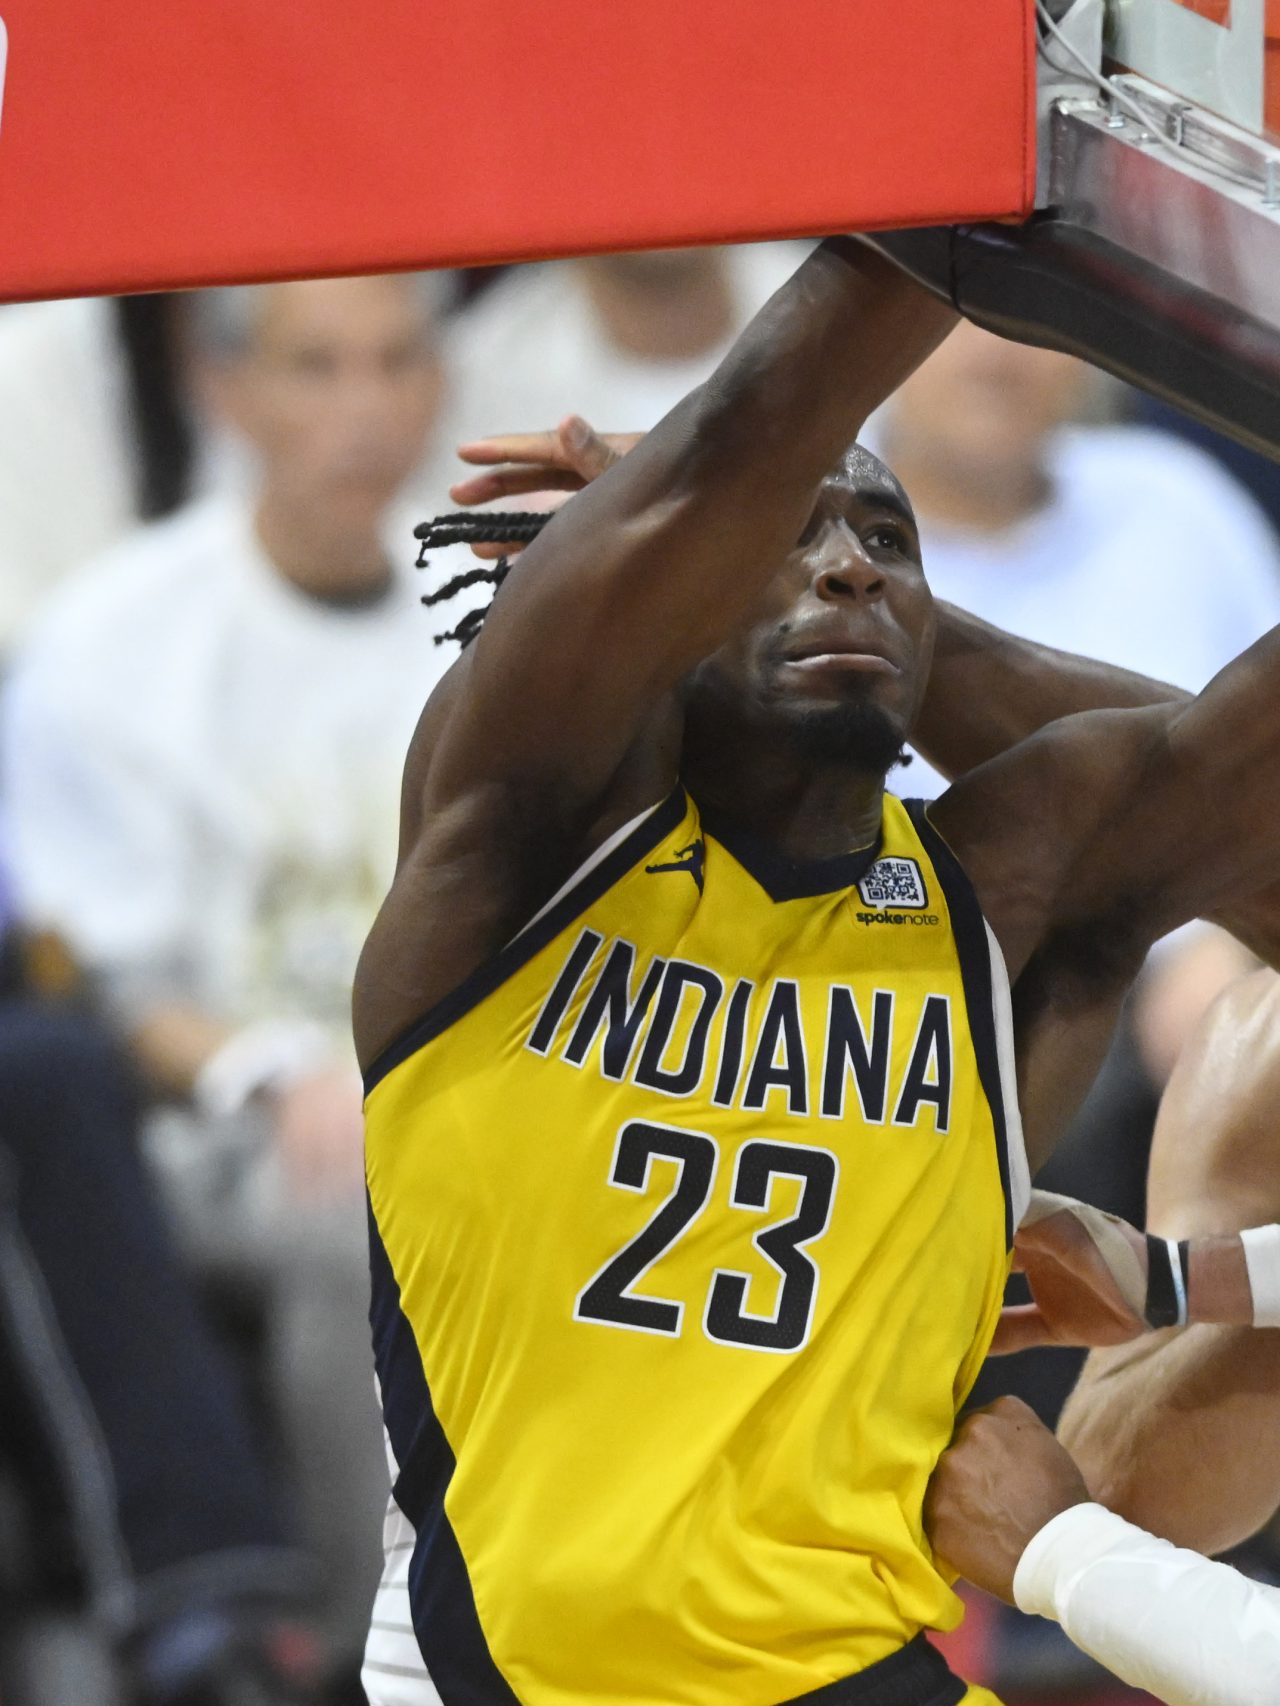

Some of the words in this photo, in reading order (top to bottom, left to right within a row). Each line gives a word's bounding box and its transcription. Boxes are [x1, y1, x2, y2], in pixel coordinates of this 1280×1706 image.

[856, 910, 939, 926] spokenote
[523, 926, 954, 1134] INDIANA
[573, 1117, 840, 1354] 23
